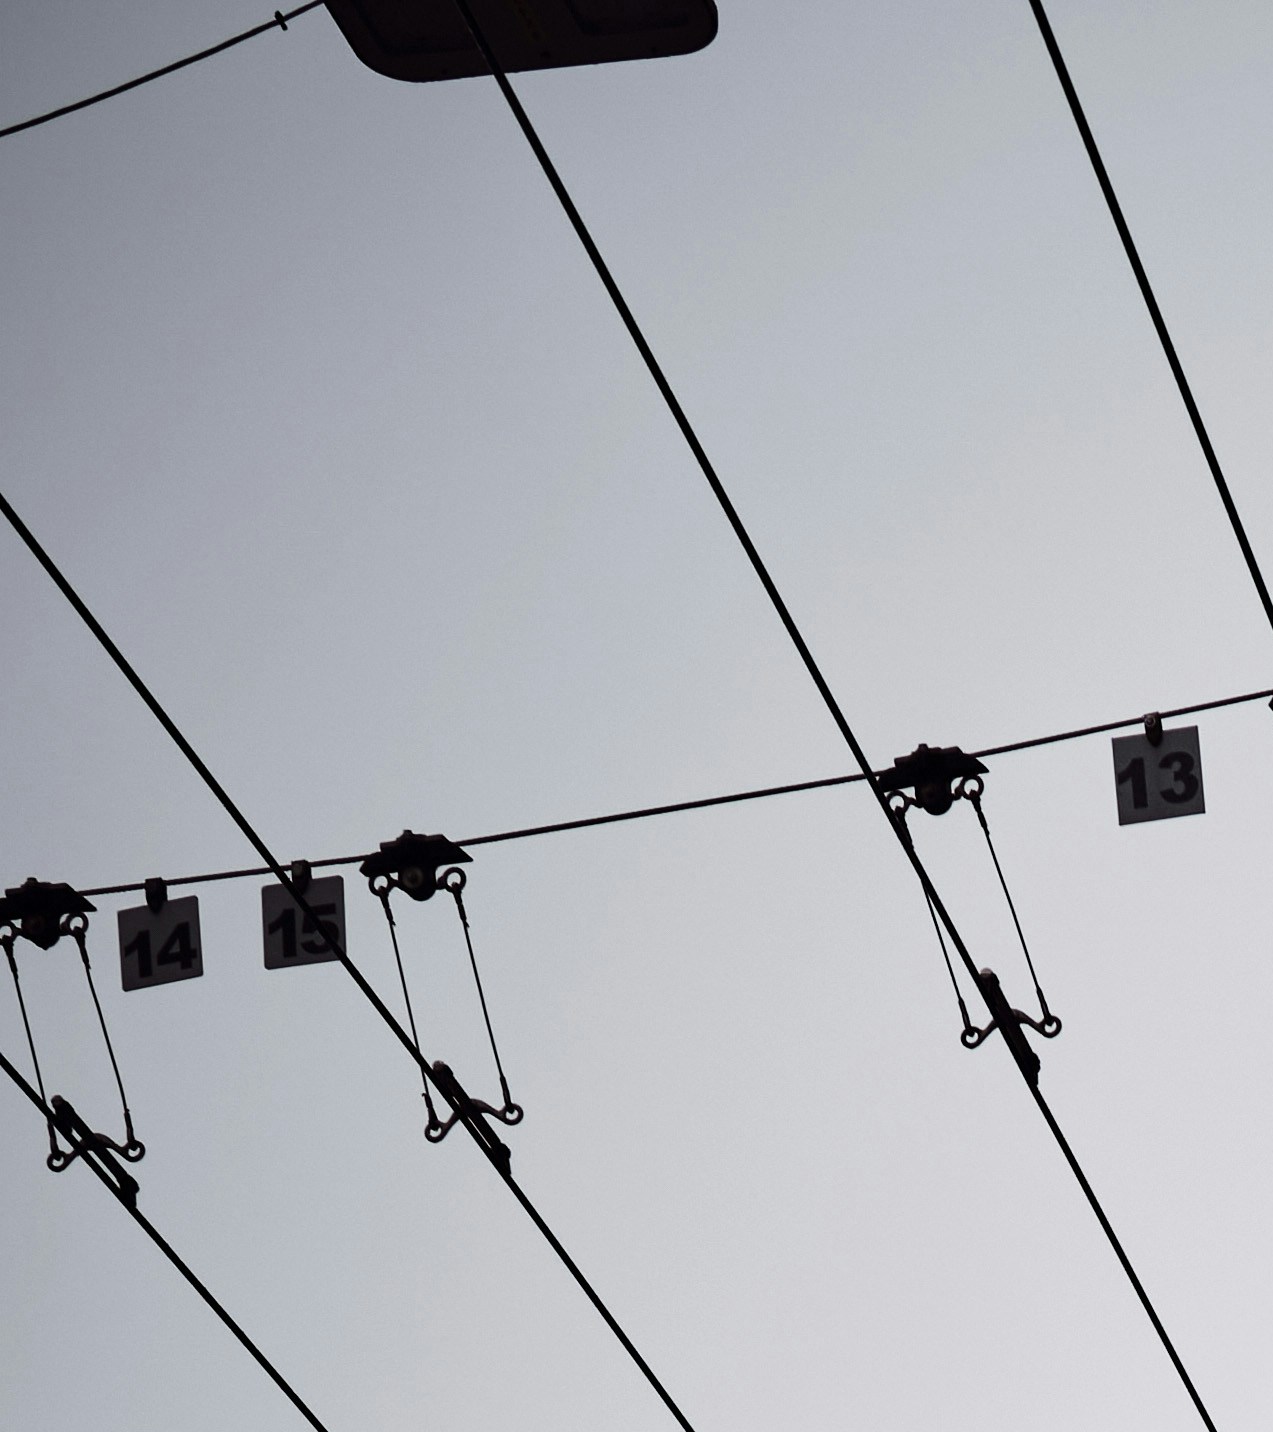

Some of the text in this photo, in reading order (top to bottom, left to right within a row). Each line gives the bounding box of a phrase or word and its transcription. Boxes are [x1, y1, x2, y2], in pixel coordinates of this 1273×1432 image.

[1118, 751, 1199, 809] 13
[125, 922, 197, 978] 14
[268, 903, 339, 958] 15
